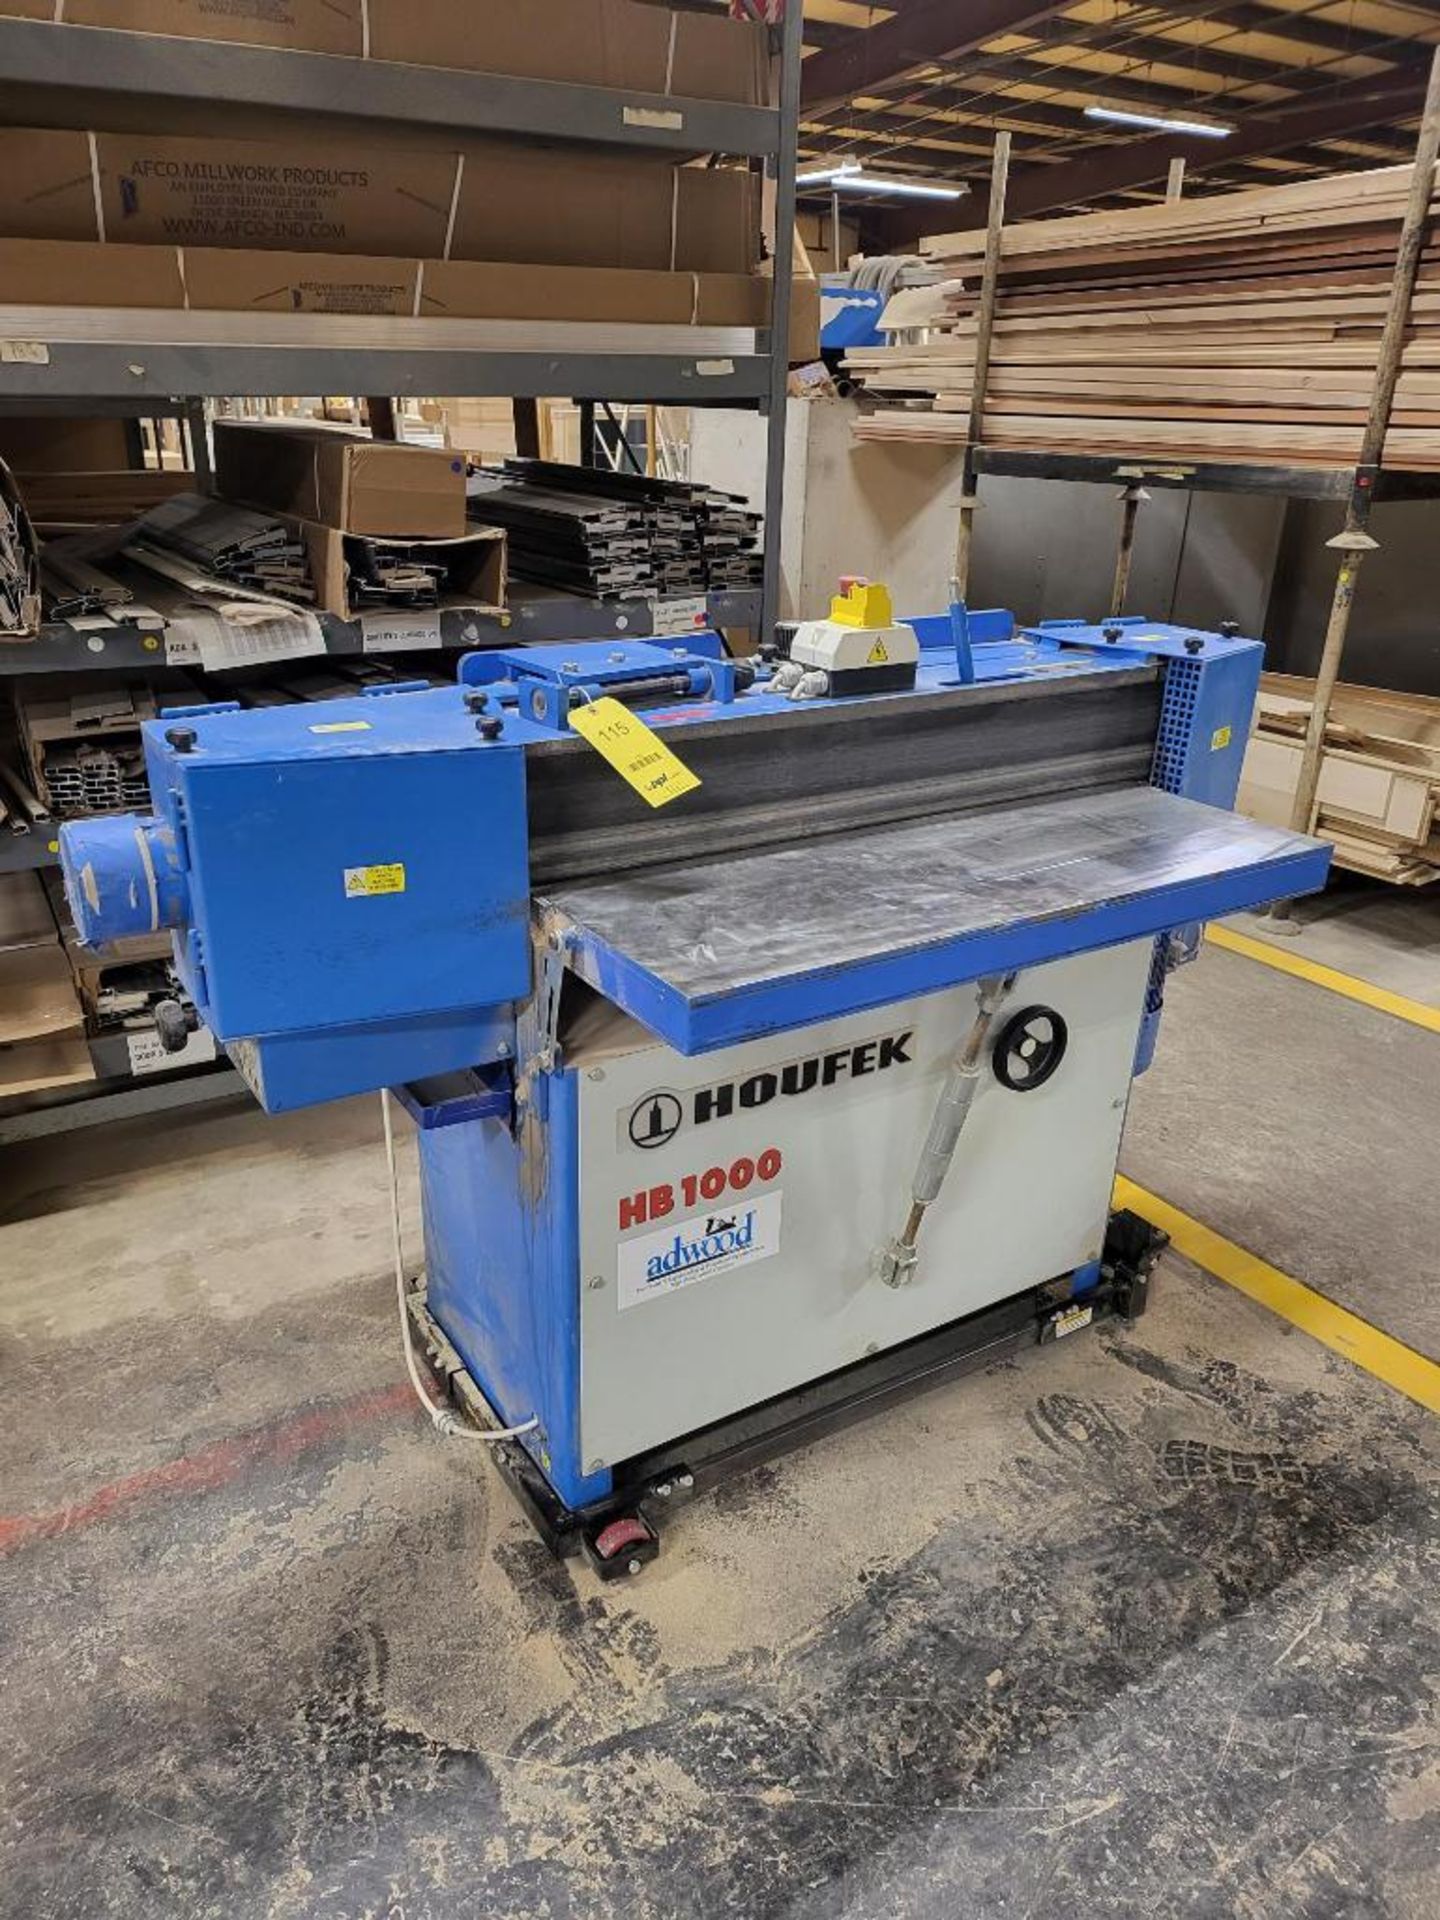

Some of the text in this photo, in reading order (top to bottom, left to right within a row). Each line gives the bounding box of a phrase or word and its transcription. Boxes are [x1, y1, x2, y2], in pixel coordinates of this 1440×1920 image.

[131, 160, 369, 188] AFCO MILLWORK PRODUCTS
[598, 720, 630, 742] 115
[694, 1031, 913, 1125] HOUFEK
[646, 1210, 754, 1277] adwood
